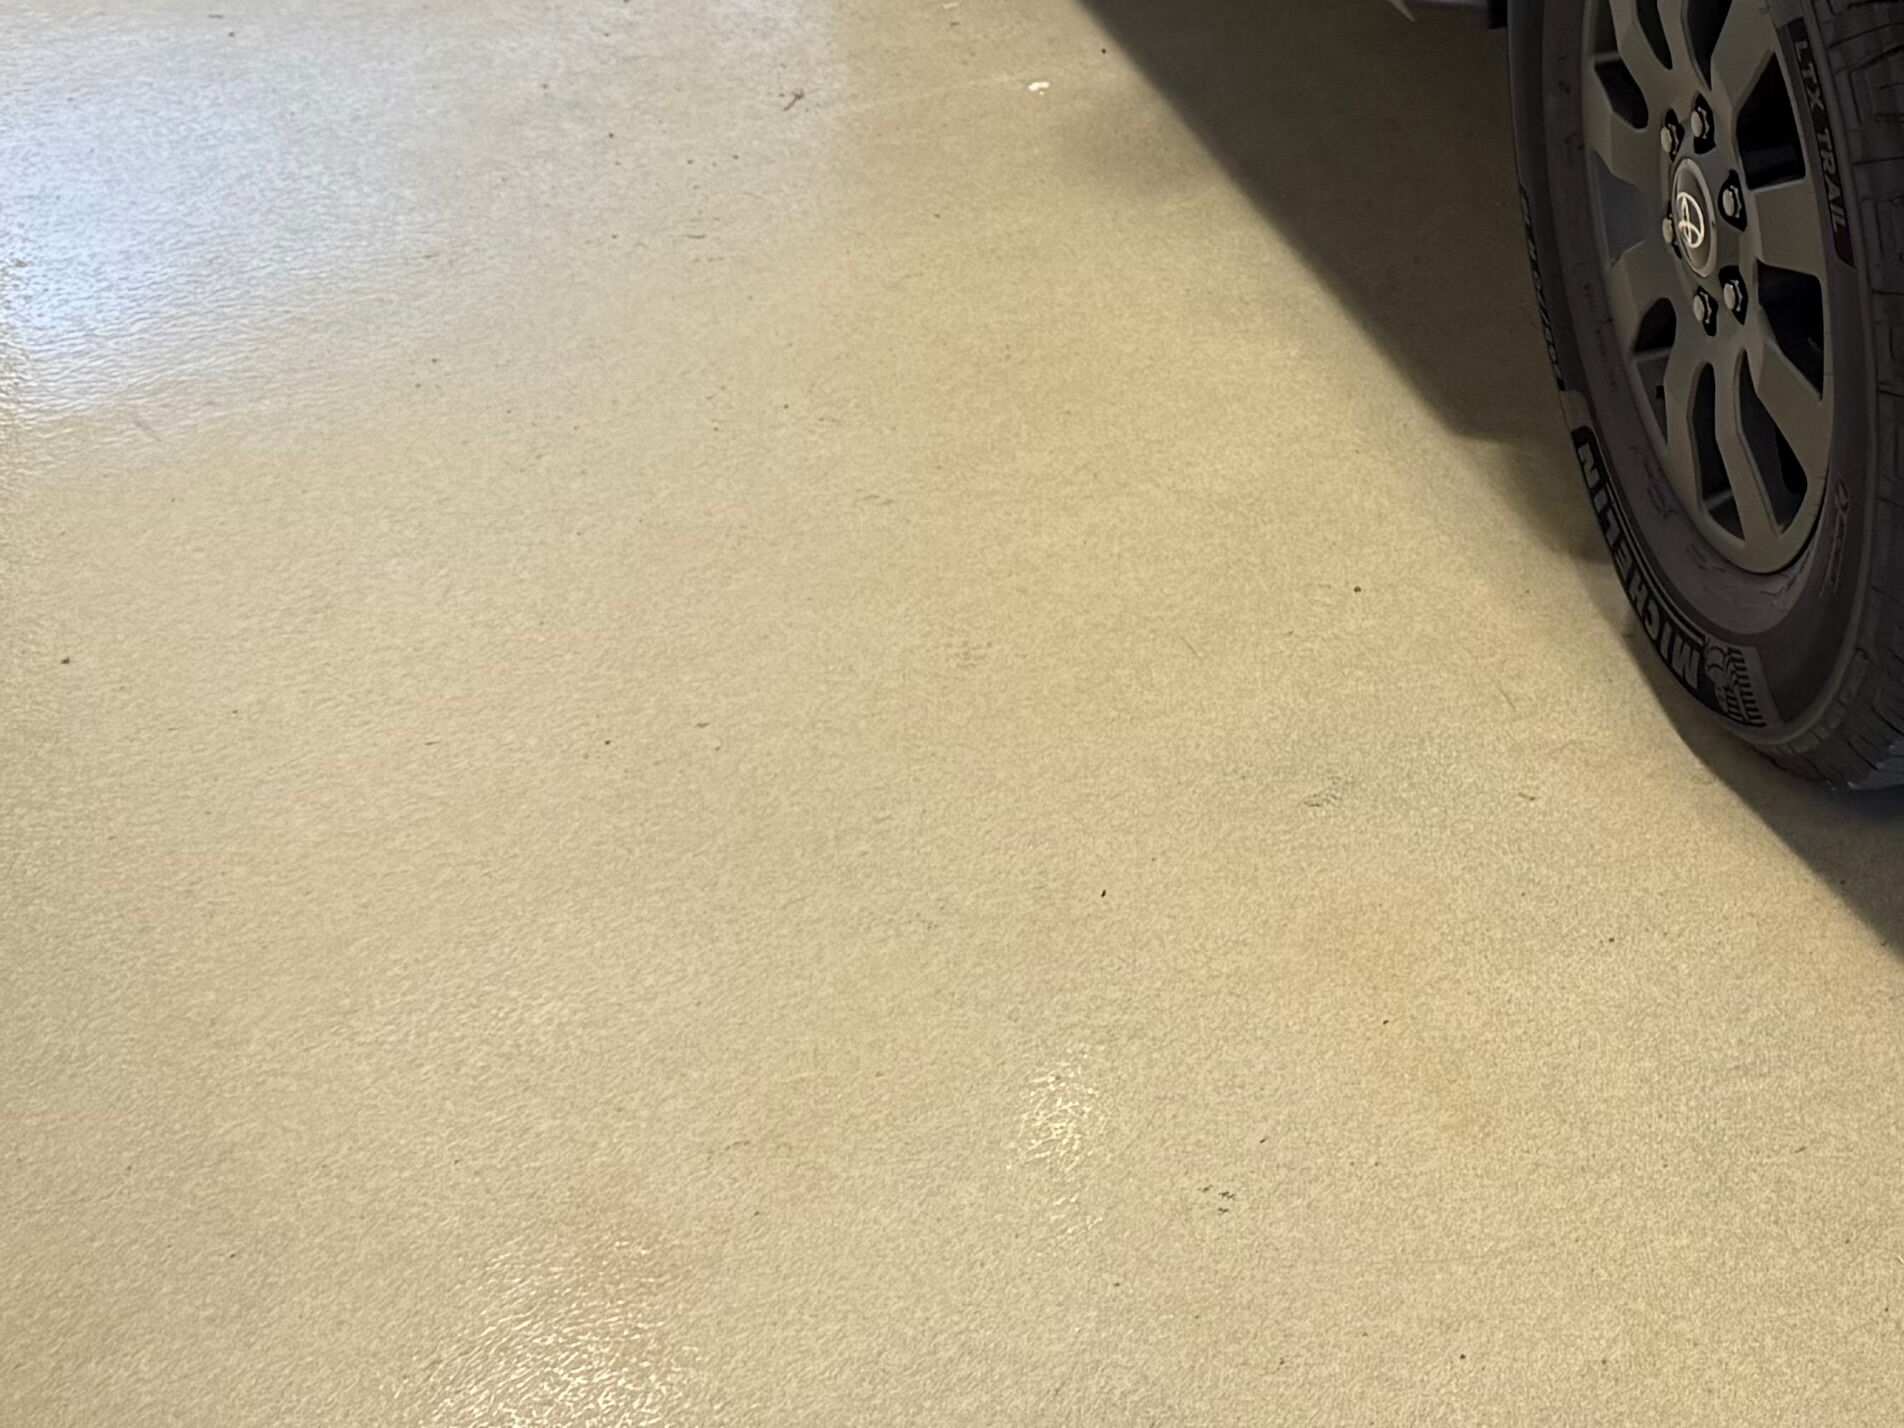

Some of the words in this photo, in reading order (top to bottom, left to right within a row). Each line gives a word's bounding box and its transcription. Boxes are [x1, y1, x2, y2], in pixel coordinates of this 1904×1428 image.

[1792, 39, 1826, 112] LTX
[1815, 127, 1846, 233] TRAIL
[1576, 440, 1702, 690] MICHELIN
